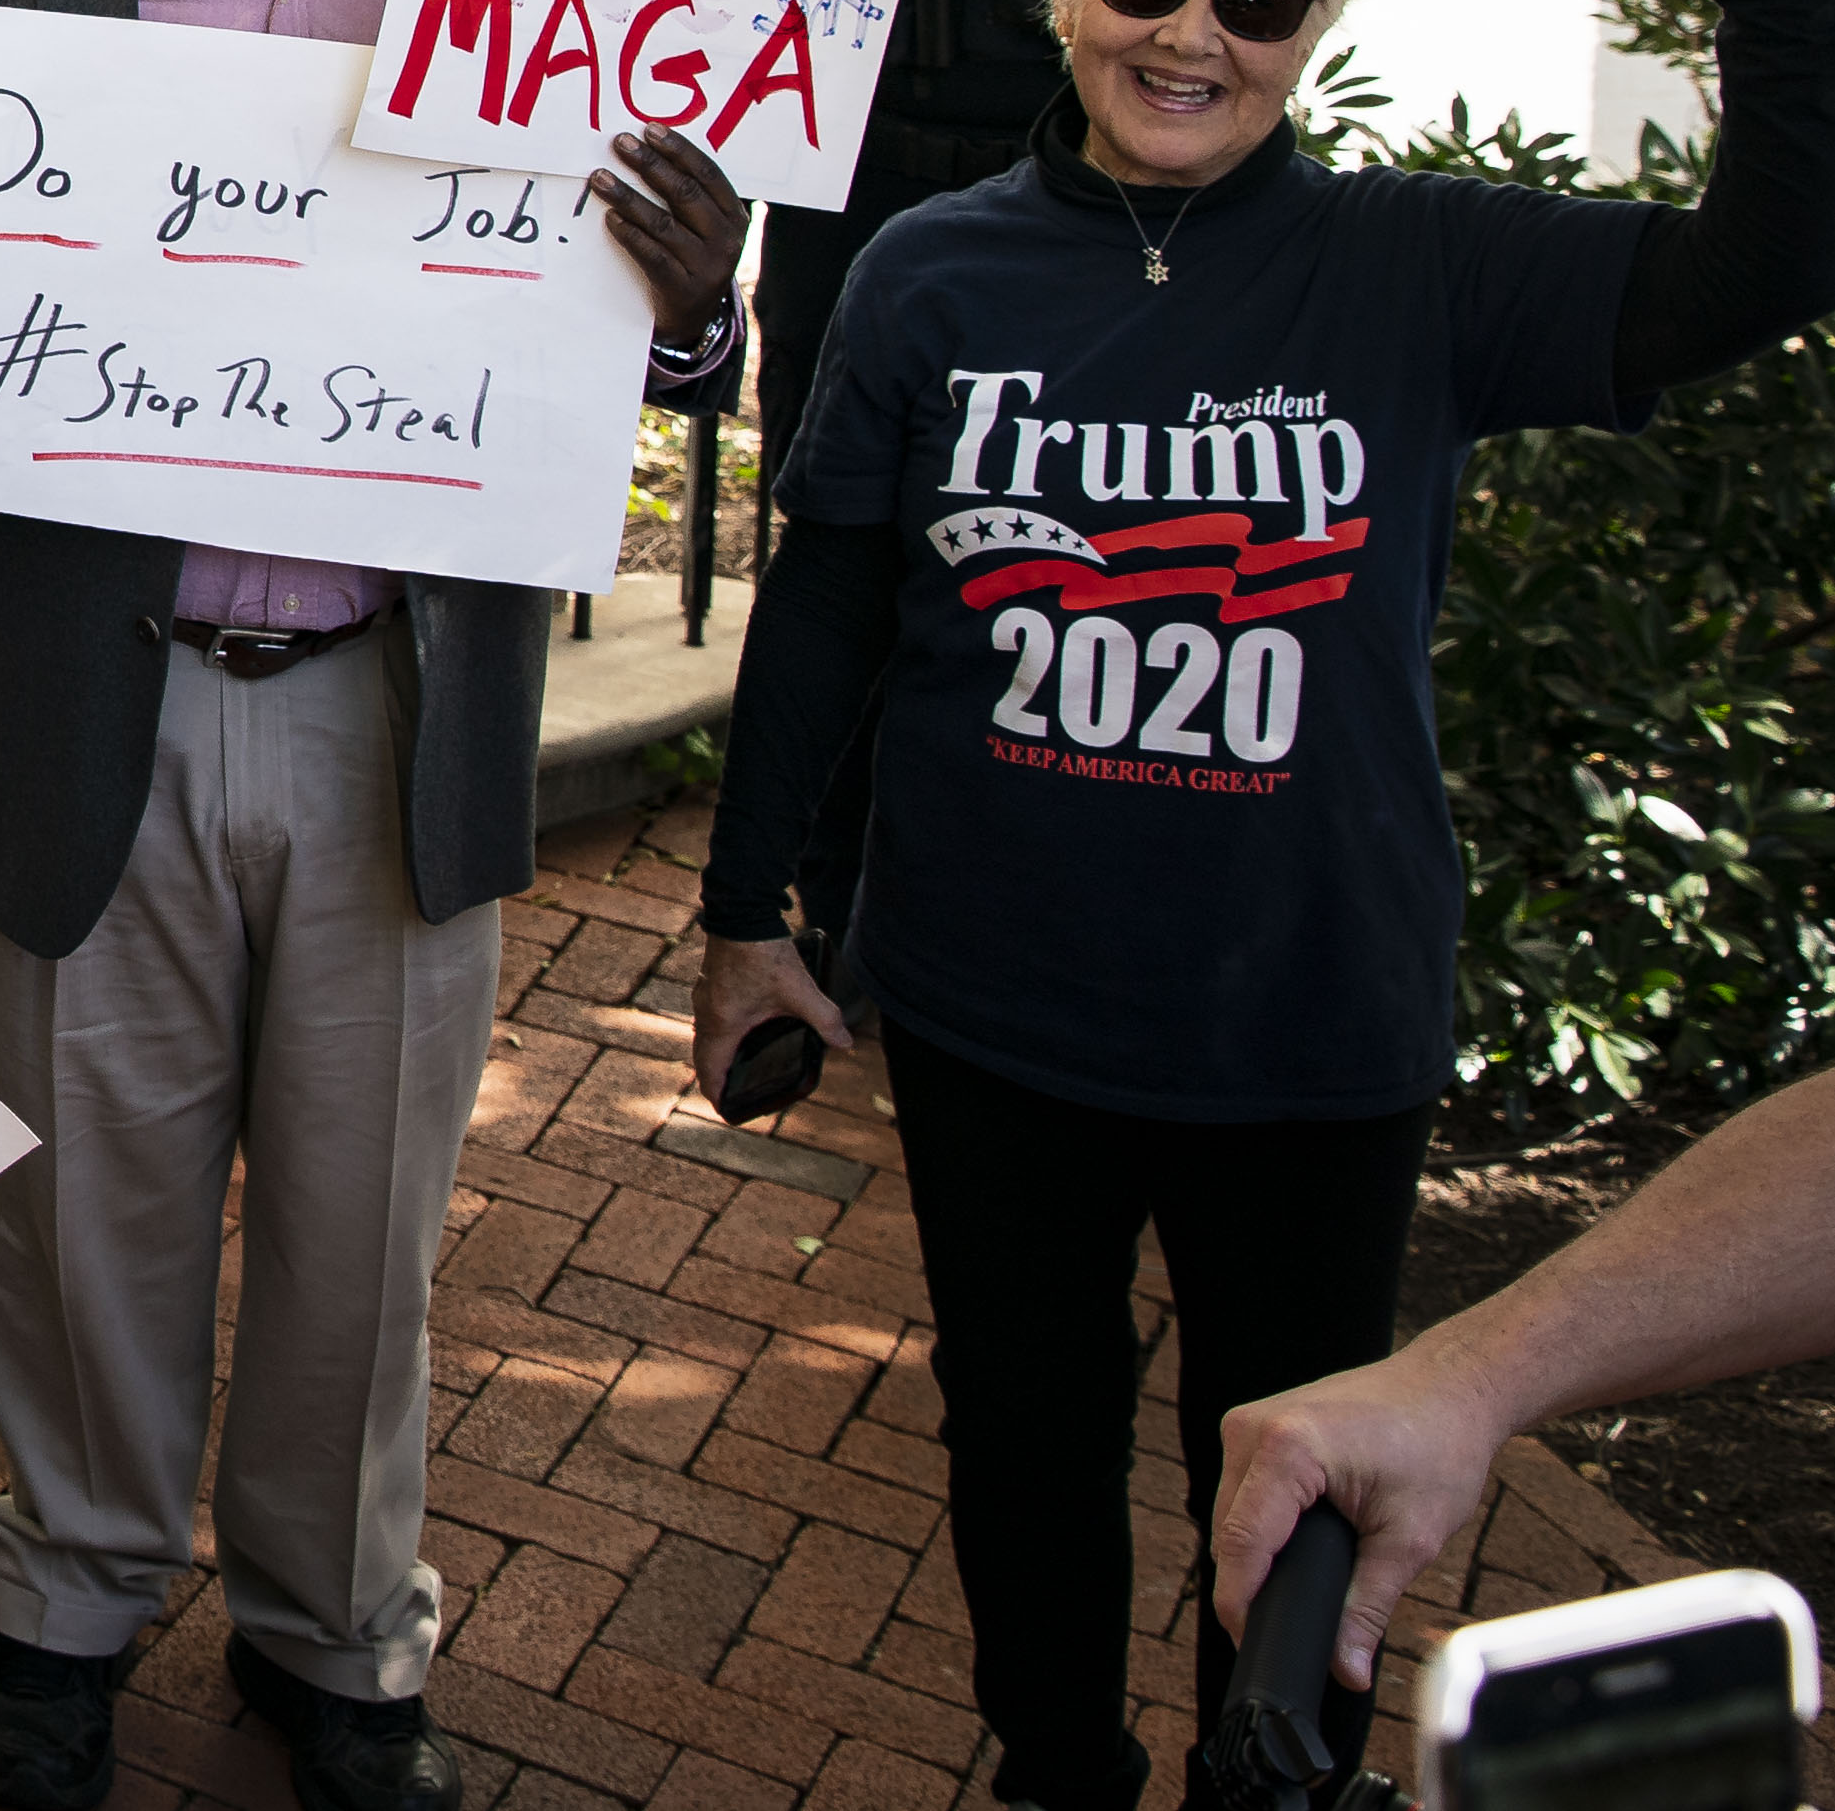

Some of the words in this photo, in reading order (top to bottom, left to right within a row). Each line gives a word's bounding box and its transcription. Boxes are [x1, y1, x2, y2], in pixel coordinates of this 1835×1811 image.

[157, 159, 329, 245] your
[413, 166, 592, 246] Job!
[1184, 384, 1328, 425] President
[937, 368, 1365, 542] Trump
[991, 606, 1304, 763] 2020
[1056, 753, 1183, 788] AMERICA
